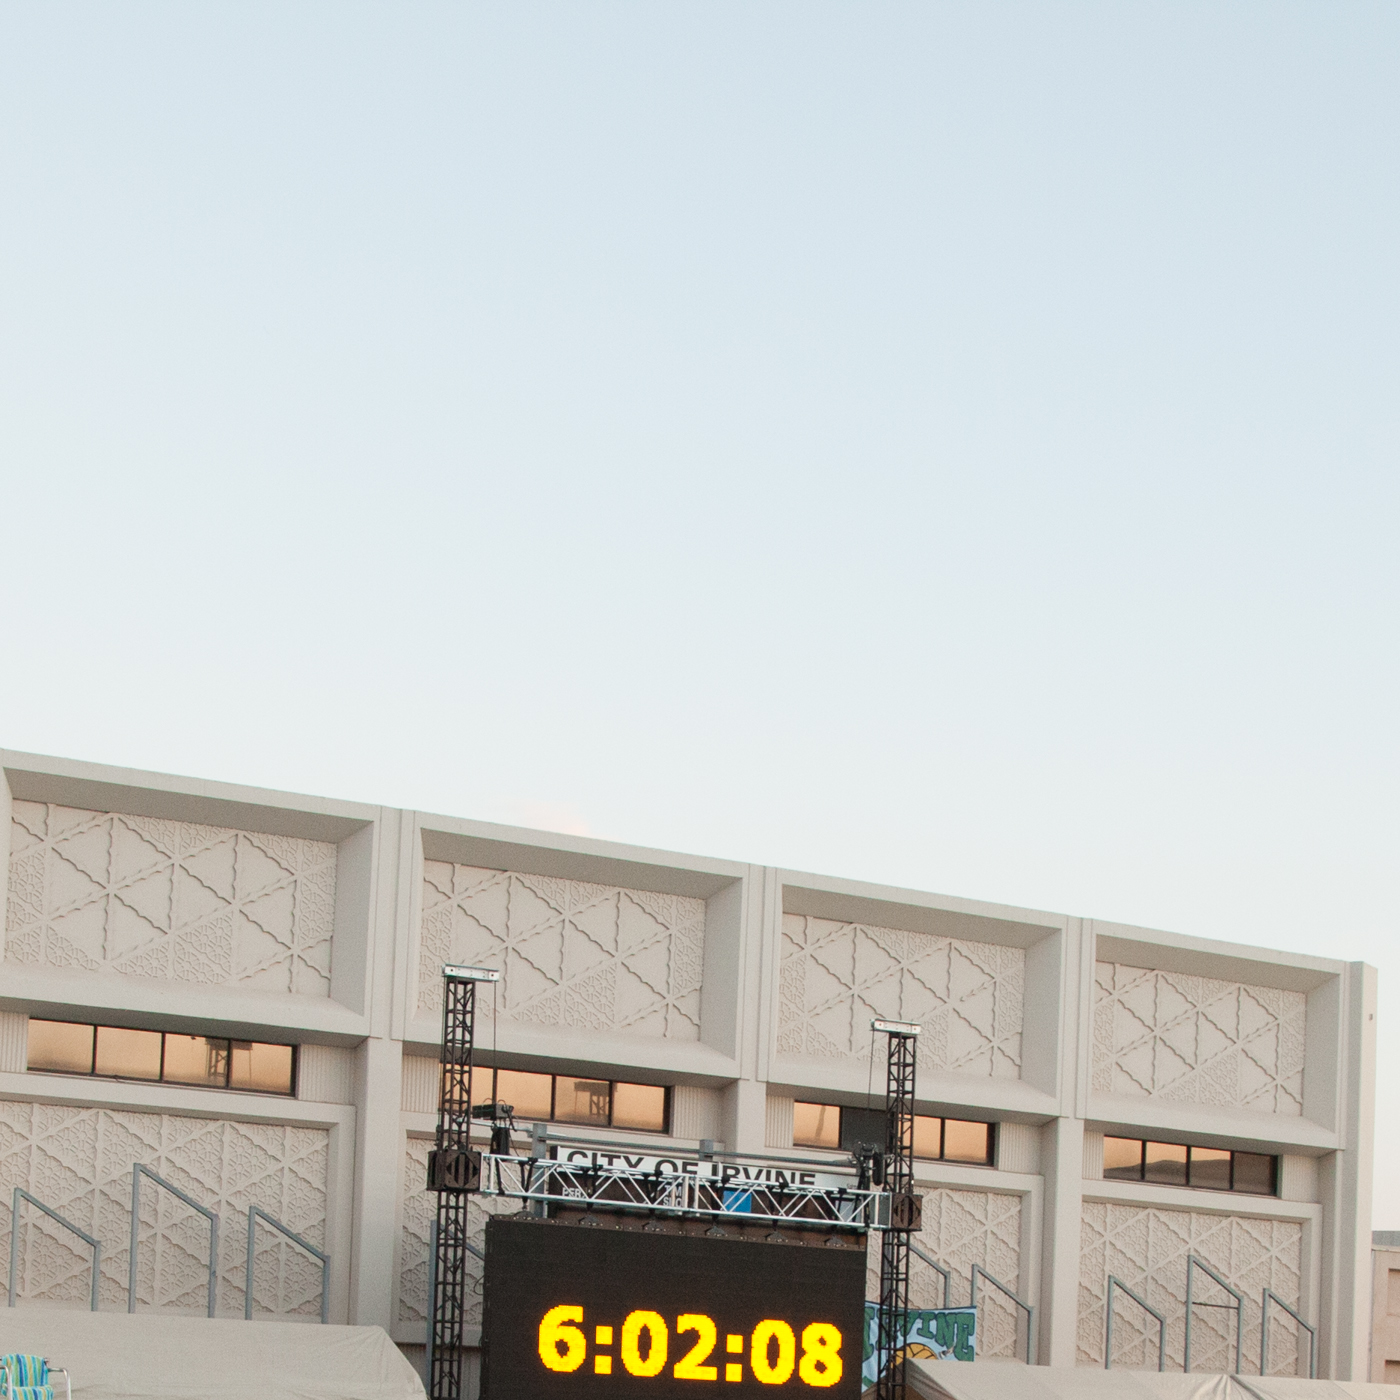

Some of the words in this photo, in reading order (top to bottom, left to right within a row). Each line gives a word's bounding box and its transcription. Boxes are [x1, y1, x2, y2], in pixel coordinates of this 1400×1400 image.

[567, 1150, 644, 1169] CITY
[711, 1164, 816, 1186] IRVINE
[538, 1304, 843, 1387] 6:02:08
